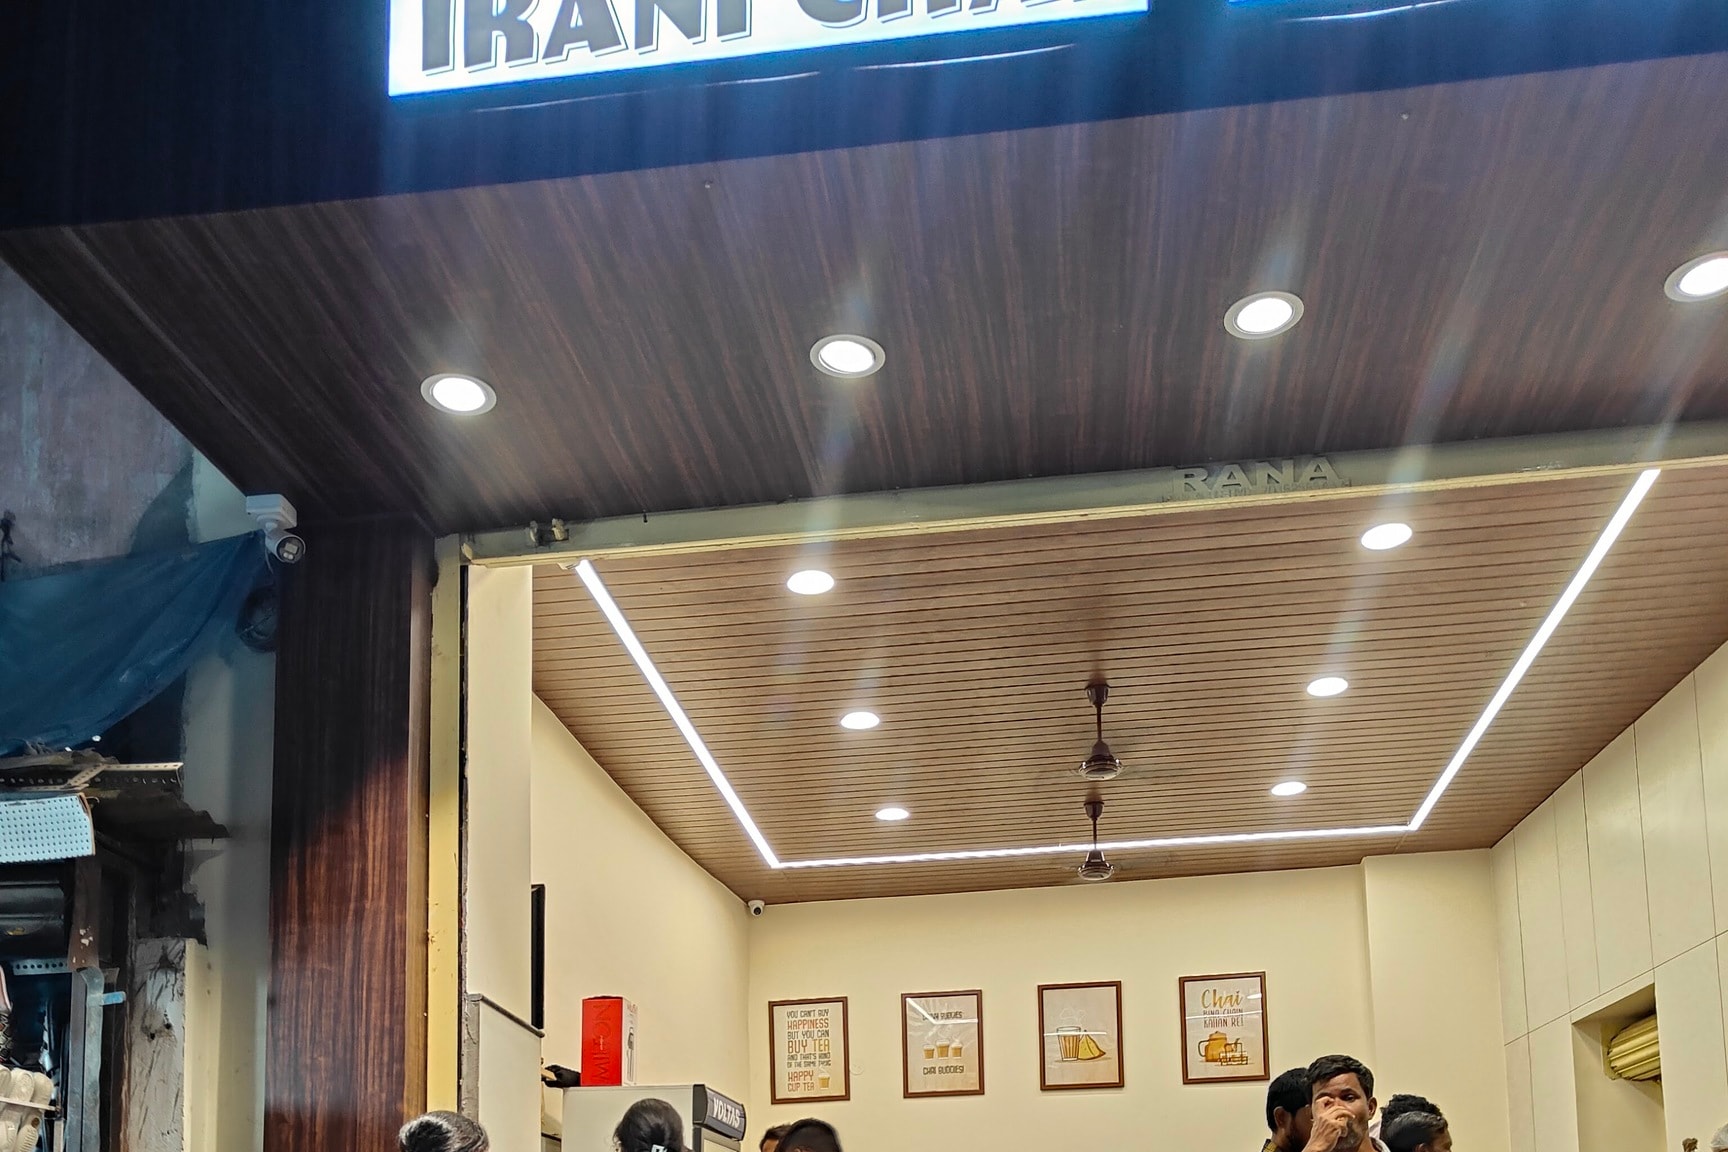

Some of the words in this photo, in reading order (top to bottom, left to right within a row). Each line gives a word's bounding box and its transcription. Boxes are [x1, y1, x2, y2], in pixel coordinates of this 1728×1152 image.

[1172, 455, 1351, 500] RANA
[1201, 988, 1243, 1009] Chai
[787, 1010, 798, 1019] YOU
[800, 1009, 816, 1018] CAN'T
[818, 1008, 829, 1017] BUY
[787, 1018, 829, 1030] HAPPINESS
[787, 1031, 799, 1040] BUT
[802, 1030, 814, 1039] YOU
[817, 1029, 829, 1038] CAN
[788, 1039, 808, 1054] BUY
[813, 1038, 830, 1052] TEA
[787, 1070, 814, 1082] HAPPY
[787, 1082, 800, 1092] CUP
[803, 1082, 815, 1091] TEA
[713, 1097, 740, 1128] VOLTAS
